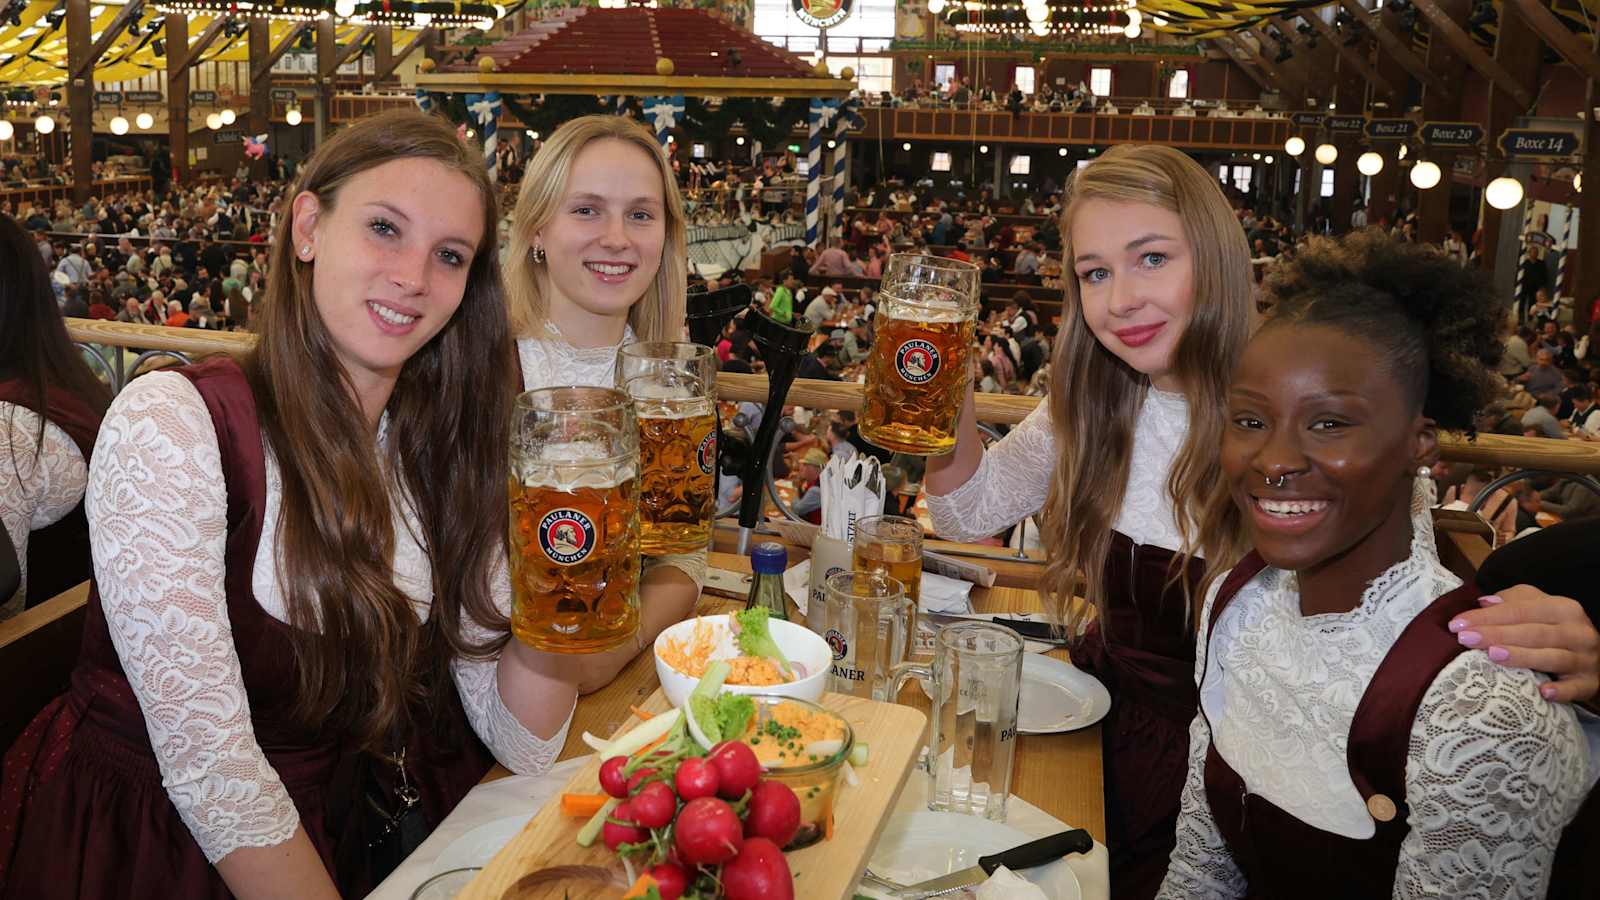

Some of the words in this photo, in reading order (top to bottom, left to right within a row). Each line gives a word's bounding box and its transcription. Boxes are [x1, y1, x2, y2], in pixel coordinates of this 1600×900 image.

[1331, 120, 1347, 128] Boxe
[1348, 120, 1360, 128] 22
[1376, 124, 1397, 133] Boxe
[1398, 124, 1408, 133] 21
[1432, 128, 1455, 139] Boxe
[1456, 129, 1473, 140] 20
[1516, 137, 1545, 149] Boxe
[1547, 137, 1564, 152] 14
[899, 341, 938, 359] PAULANER
[900, 367, 931, 381] MÜNCHEN
[541, 511, 592, 531] PAULANER
[546, 547, 588, 563] MÜNCHEN
